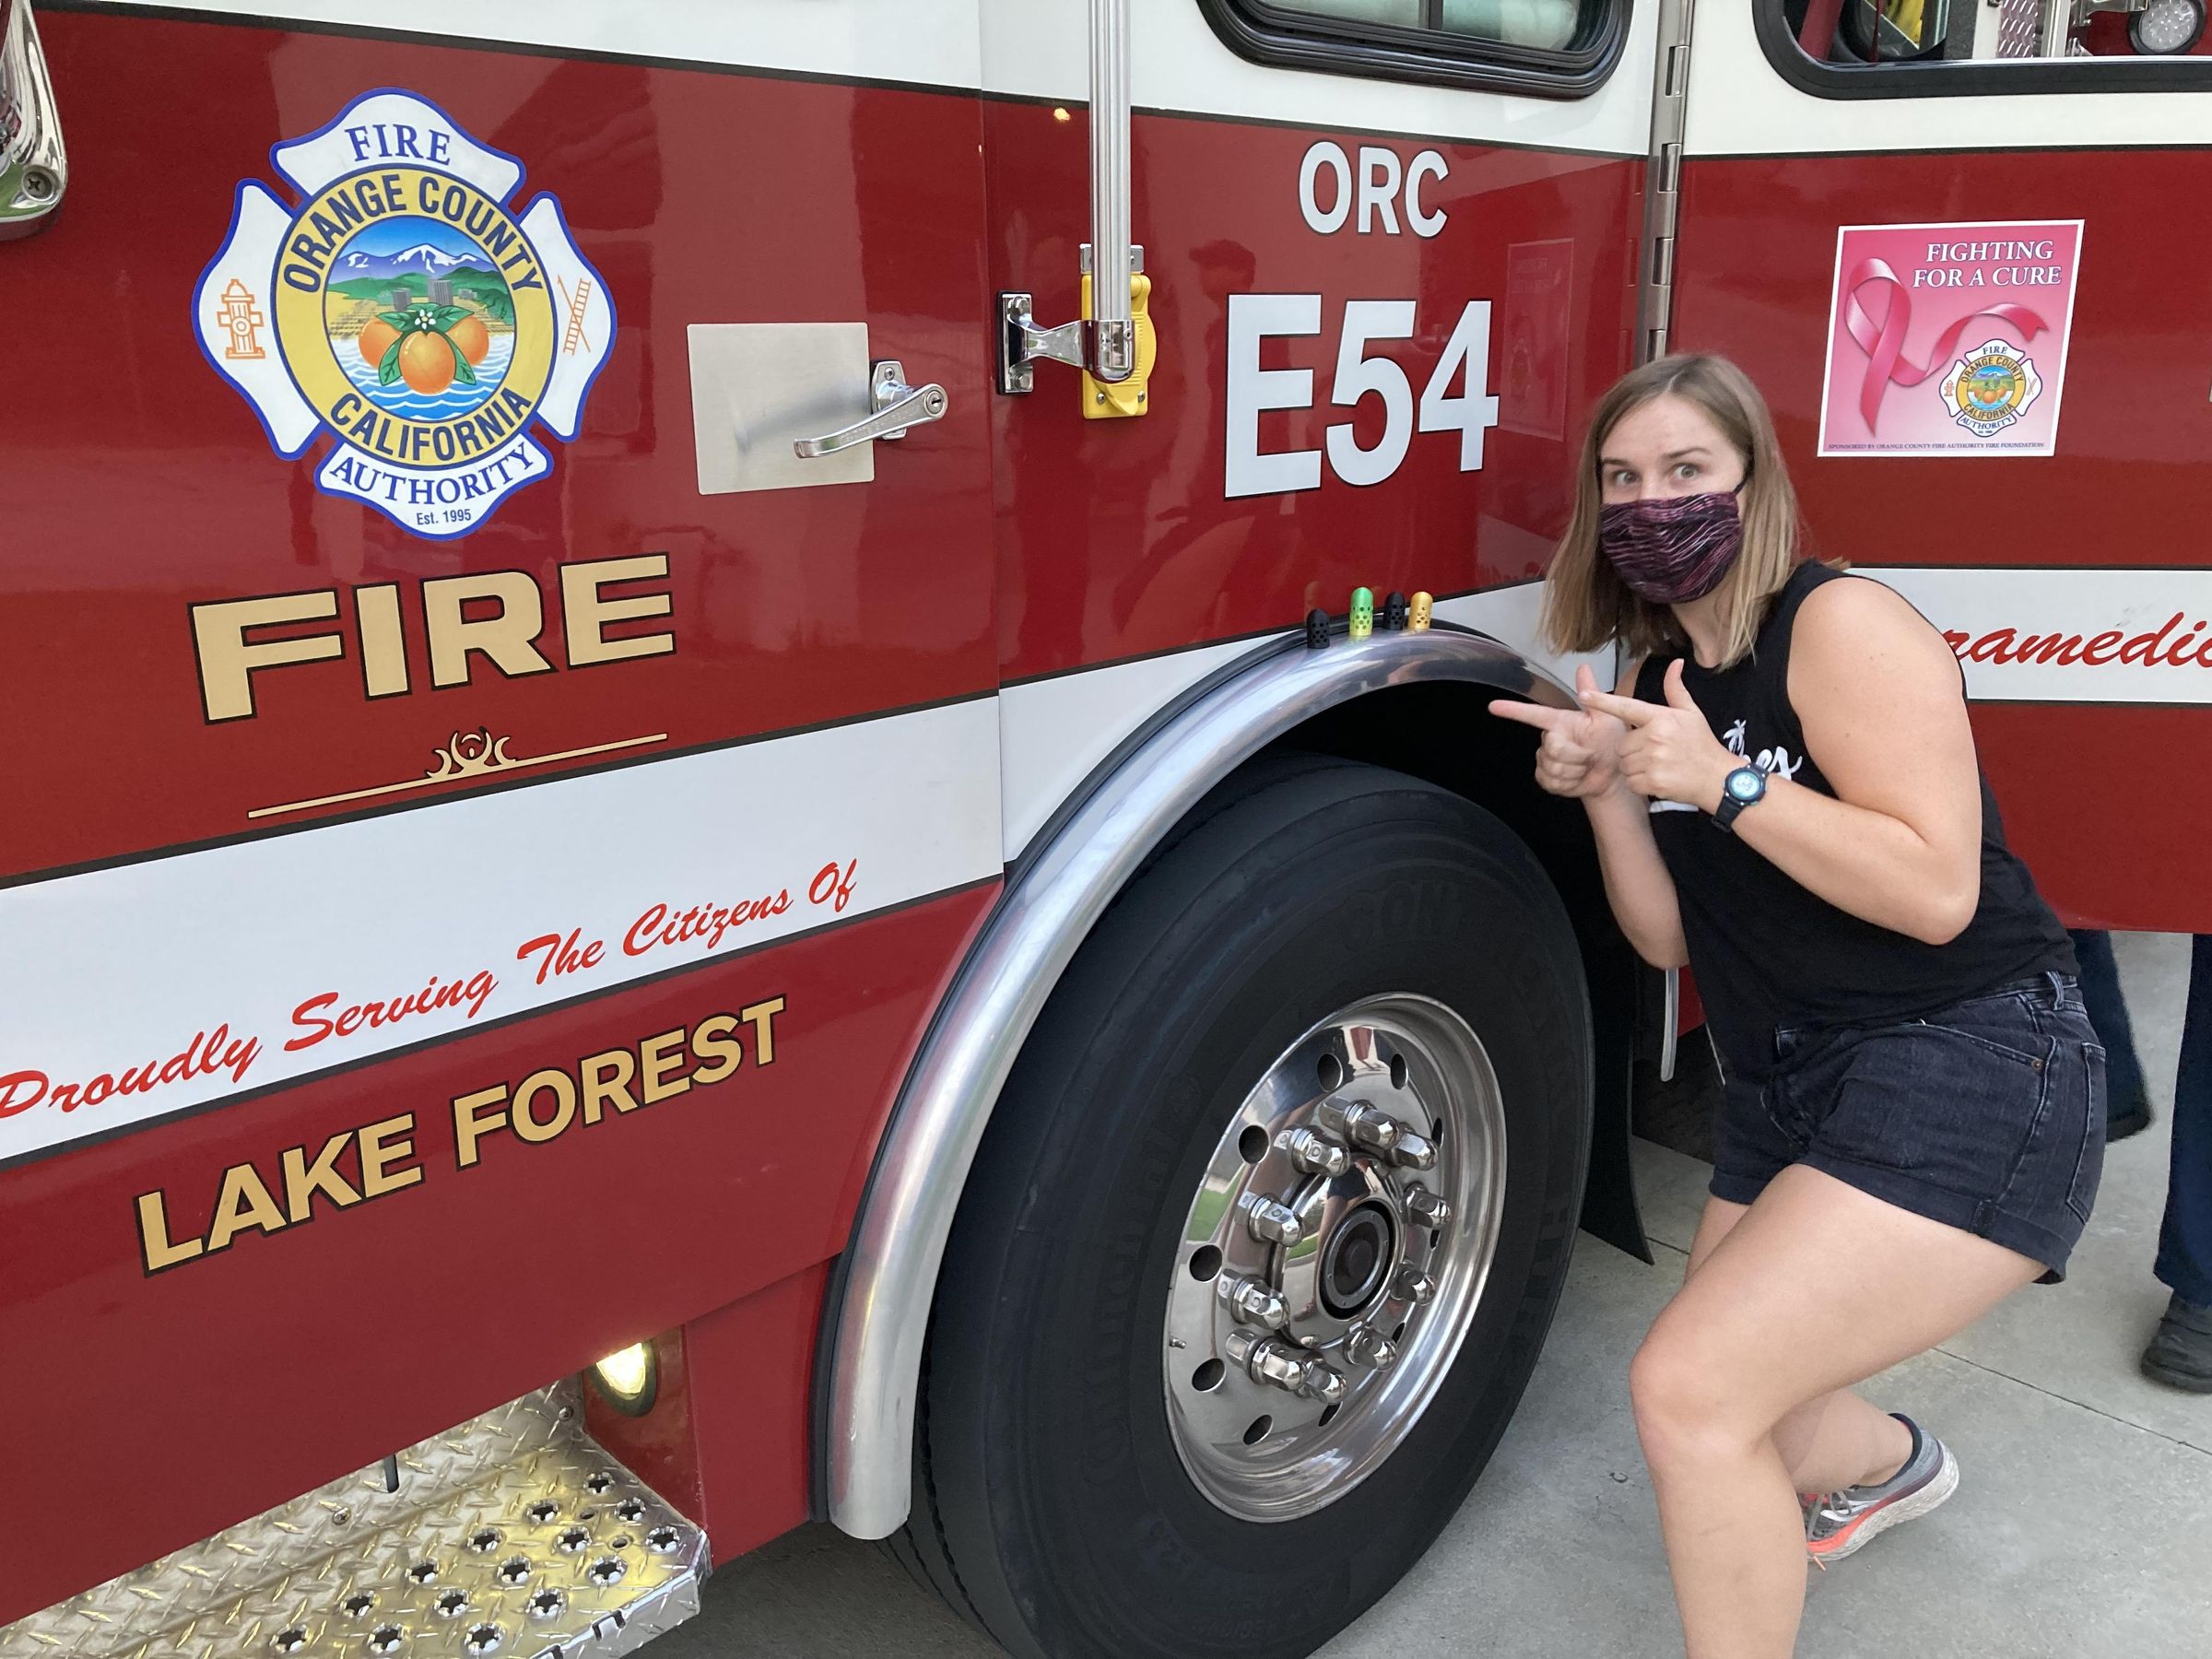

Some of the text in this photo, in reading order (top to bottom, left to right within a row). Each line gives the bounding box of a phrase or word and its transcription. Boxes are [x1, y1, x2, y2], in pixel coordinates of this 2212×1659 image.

[345, 123, 451, 166] FIRE
[1298, 140, 1450, 239] ORC
[283, 173, 544, 296] ORANGE COUNTY
[1925, 240, 2054, 263] FIGHTING
[1912, 265, 2063, 288] FOR A CURE
[1960, 356, 2024, 383] ORANGE COUNTY
[1983, 346, 2008, 355] FIRE
[1224, 292, 1500, 500] E54
[1959, 415, 2012, 429] AUTHORITY
[1963, 403, 2015, 420] CALIFORNIA
[329, 387, 533, 462] CALIFORNIA
[328, 441, 535, 506] AUTHORITY
[416, 508, 472, 526] Est. 1995
[187, 552, 677, 725] FIRE
[283, 969, 499, 1053] Serving
[516, 927, 606, 985] The
[623, 888, 794, 957] Citizens
[807, 857, 858, 912] Of
[133, 994, 788, 1278] LAKE FOREST
